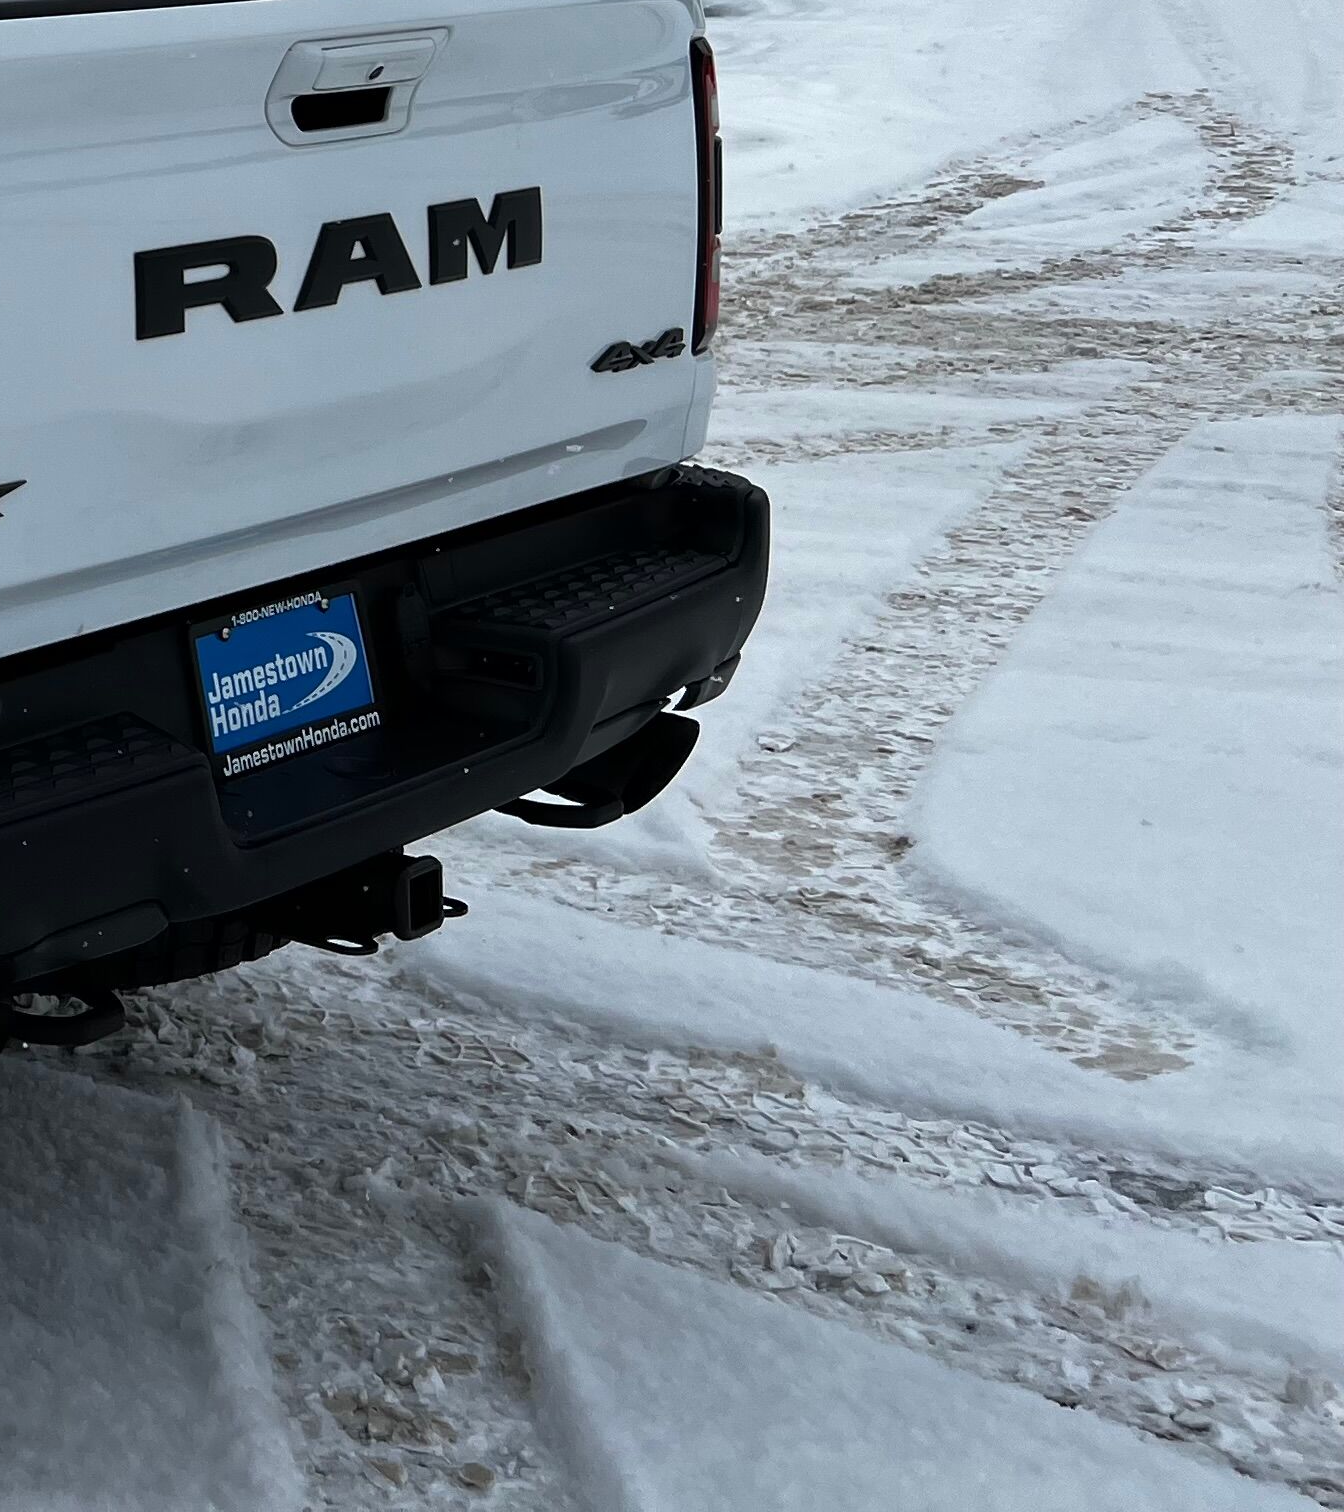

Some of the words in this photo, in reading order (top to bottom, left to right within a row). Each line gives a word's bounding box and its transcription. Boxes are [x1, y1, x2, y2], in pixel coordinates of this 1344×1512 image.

[133, 186, 542, 341] RAM
[208, 644, 328, 704] Jamestown
[210, 690, 281, 738] Honda
[223, 710, 381, 777] JamestownHonda.com
